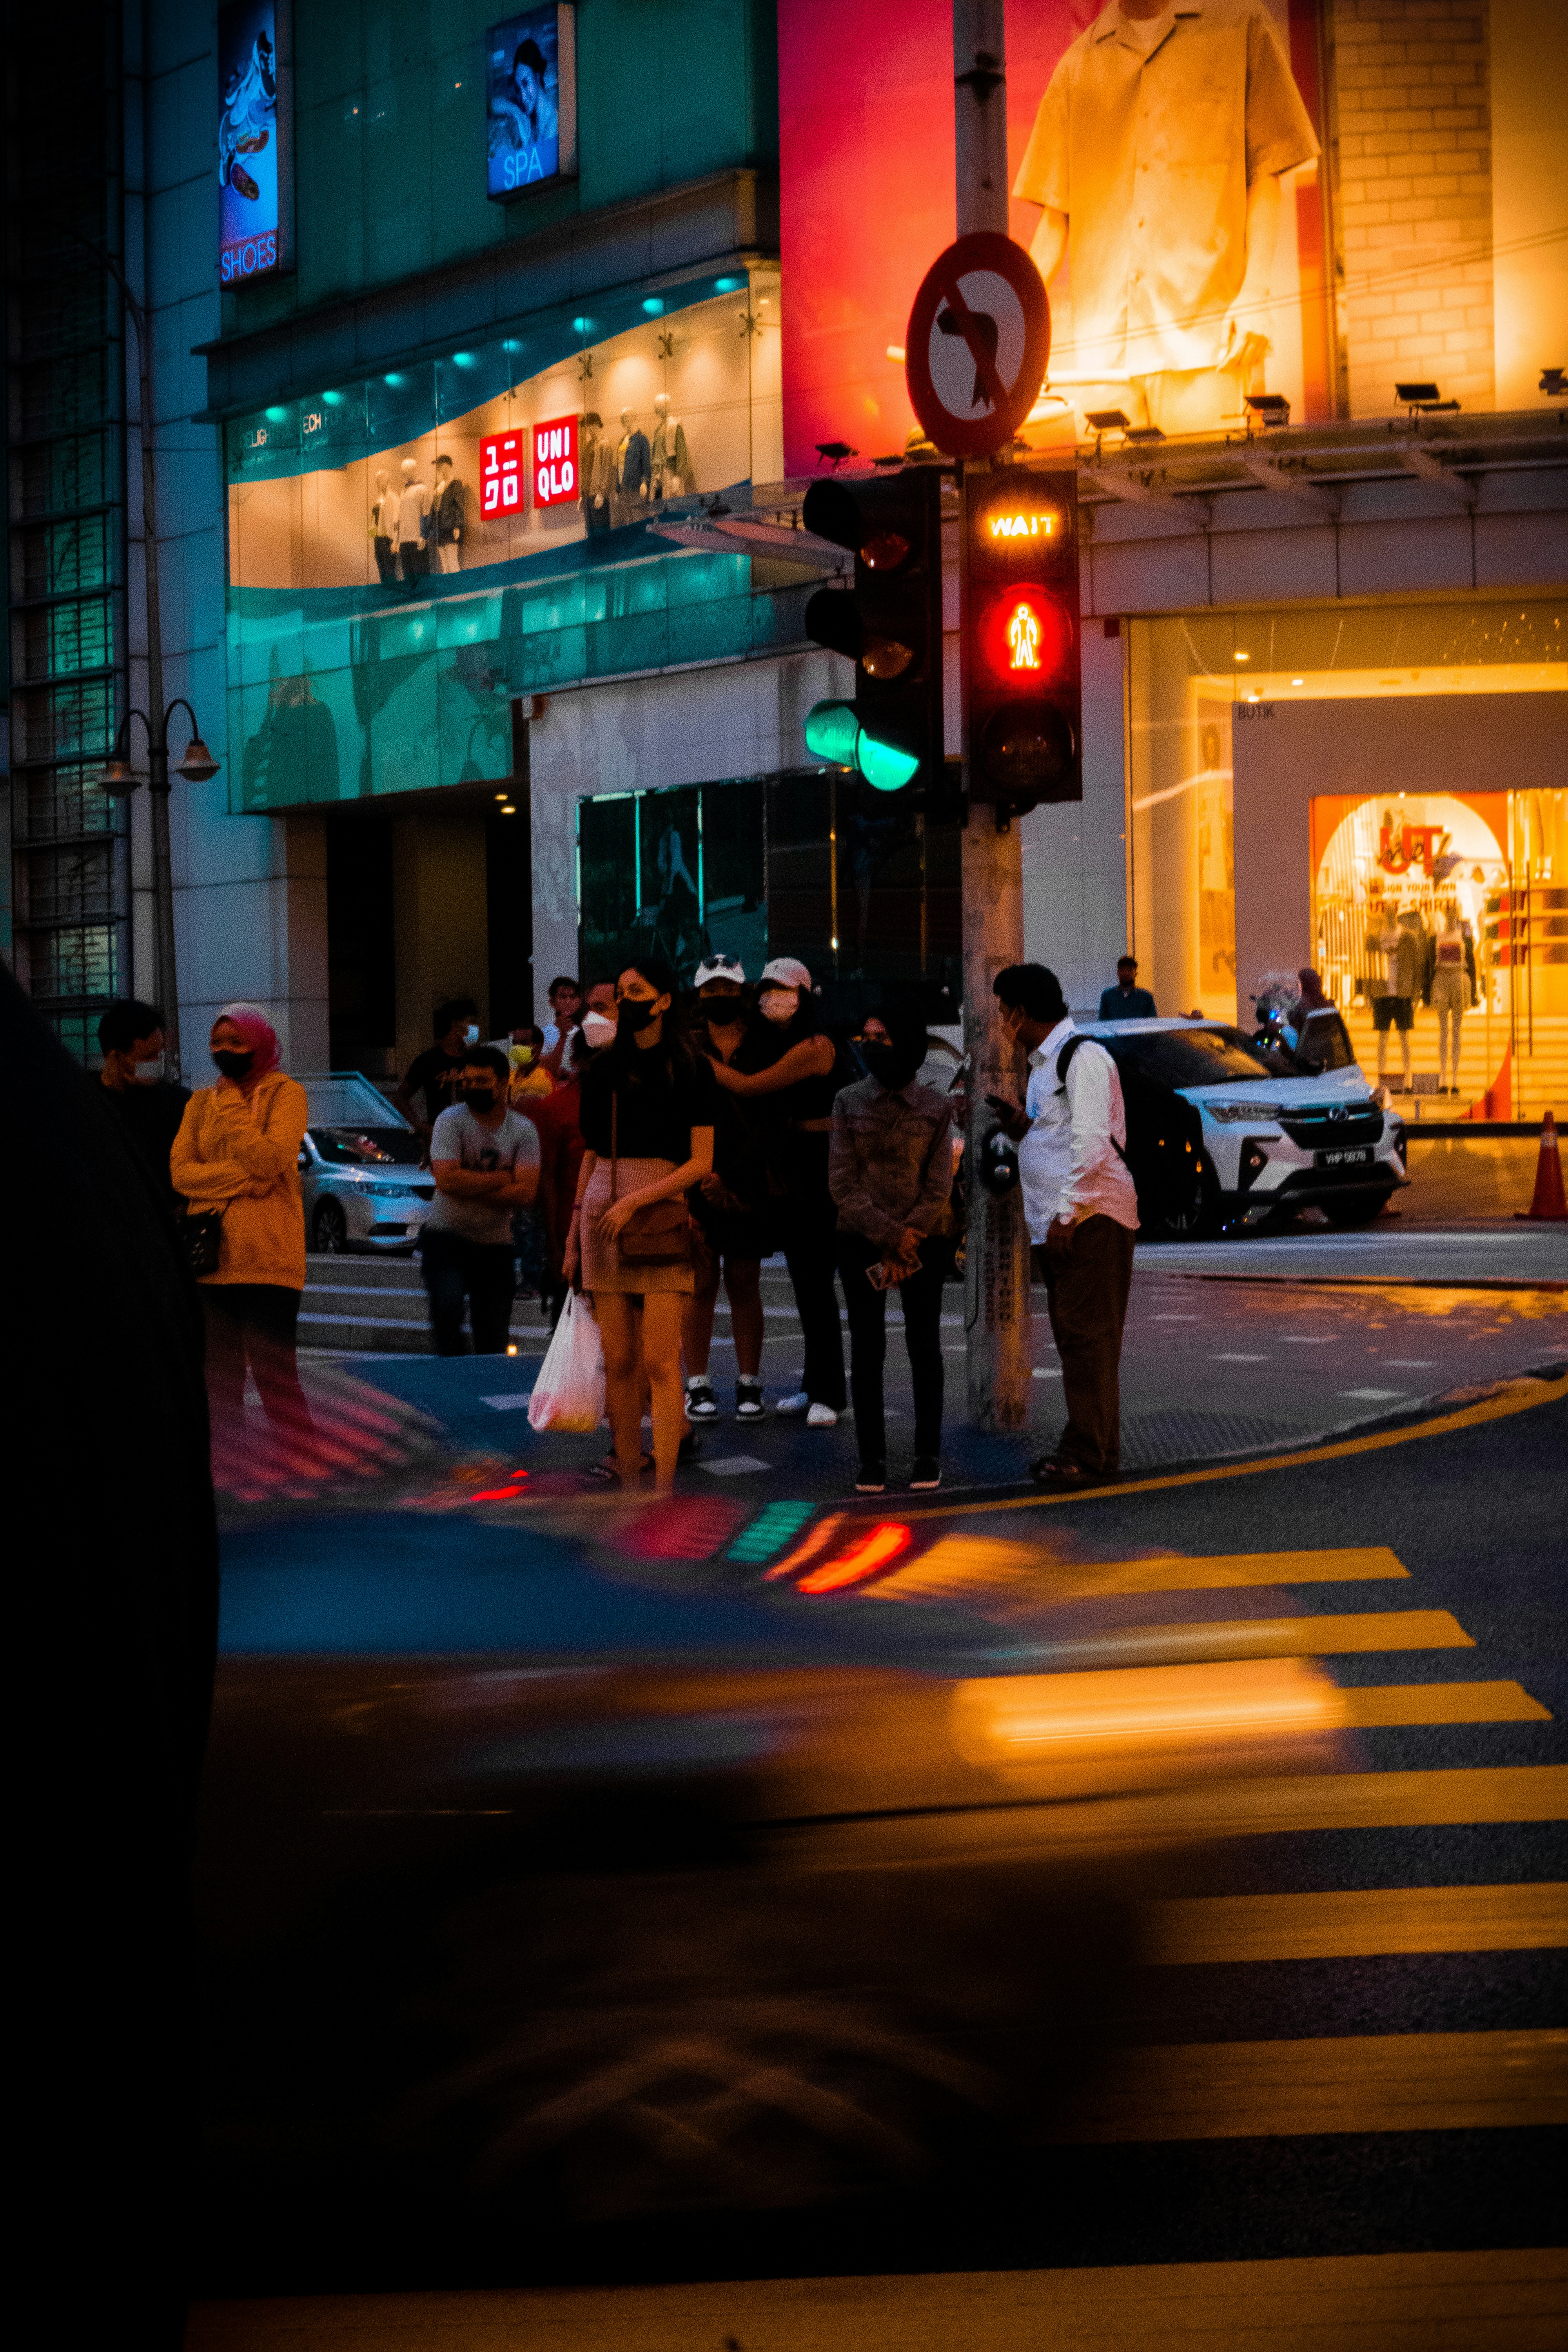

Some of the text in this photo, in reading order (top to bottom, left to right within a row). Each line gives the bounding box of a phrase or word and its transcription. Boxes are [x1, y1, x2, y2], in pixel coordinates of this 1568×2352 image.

[504, 147, 544, 190] SPA
[221, 235, 276, 282] SHOES
[537, 426, 570, 462] UNI
[538, 461, 573, 501] QLO
[989, 514, 1056, 537] WAIT
[1238, 704, 1274, 720] BUTIK
